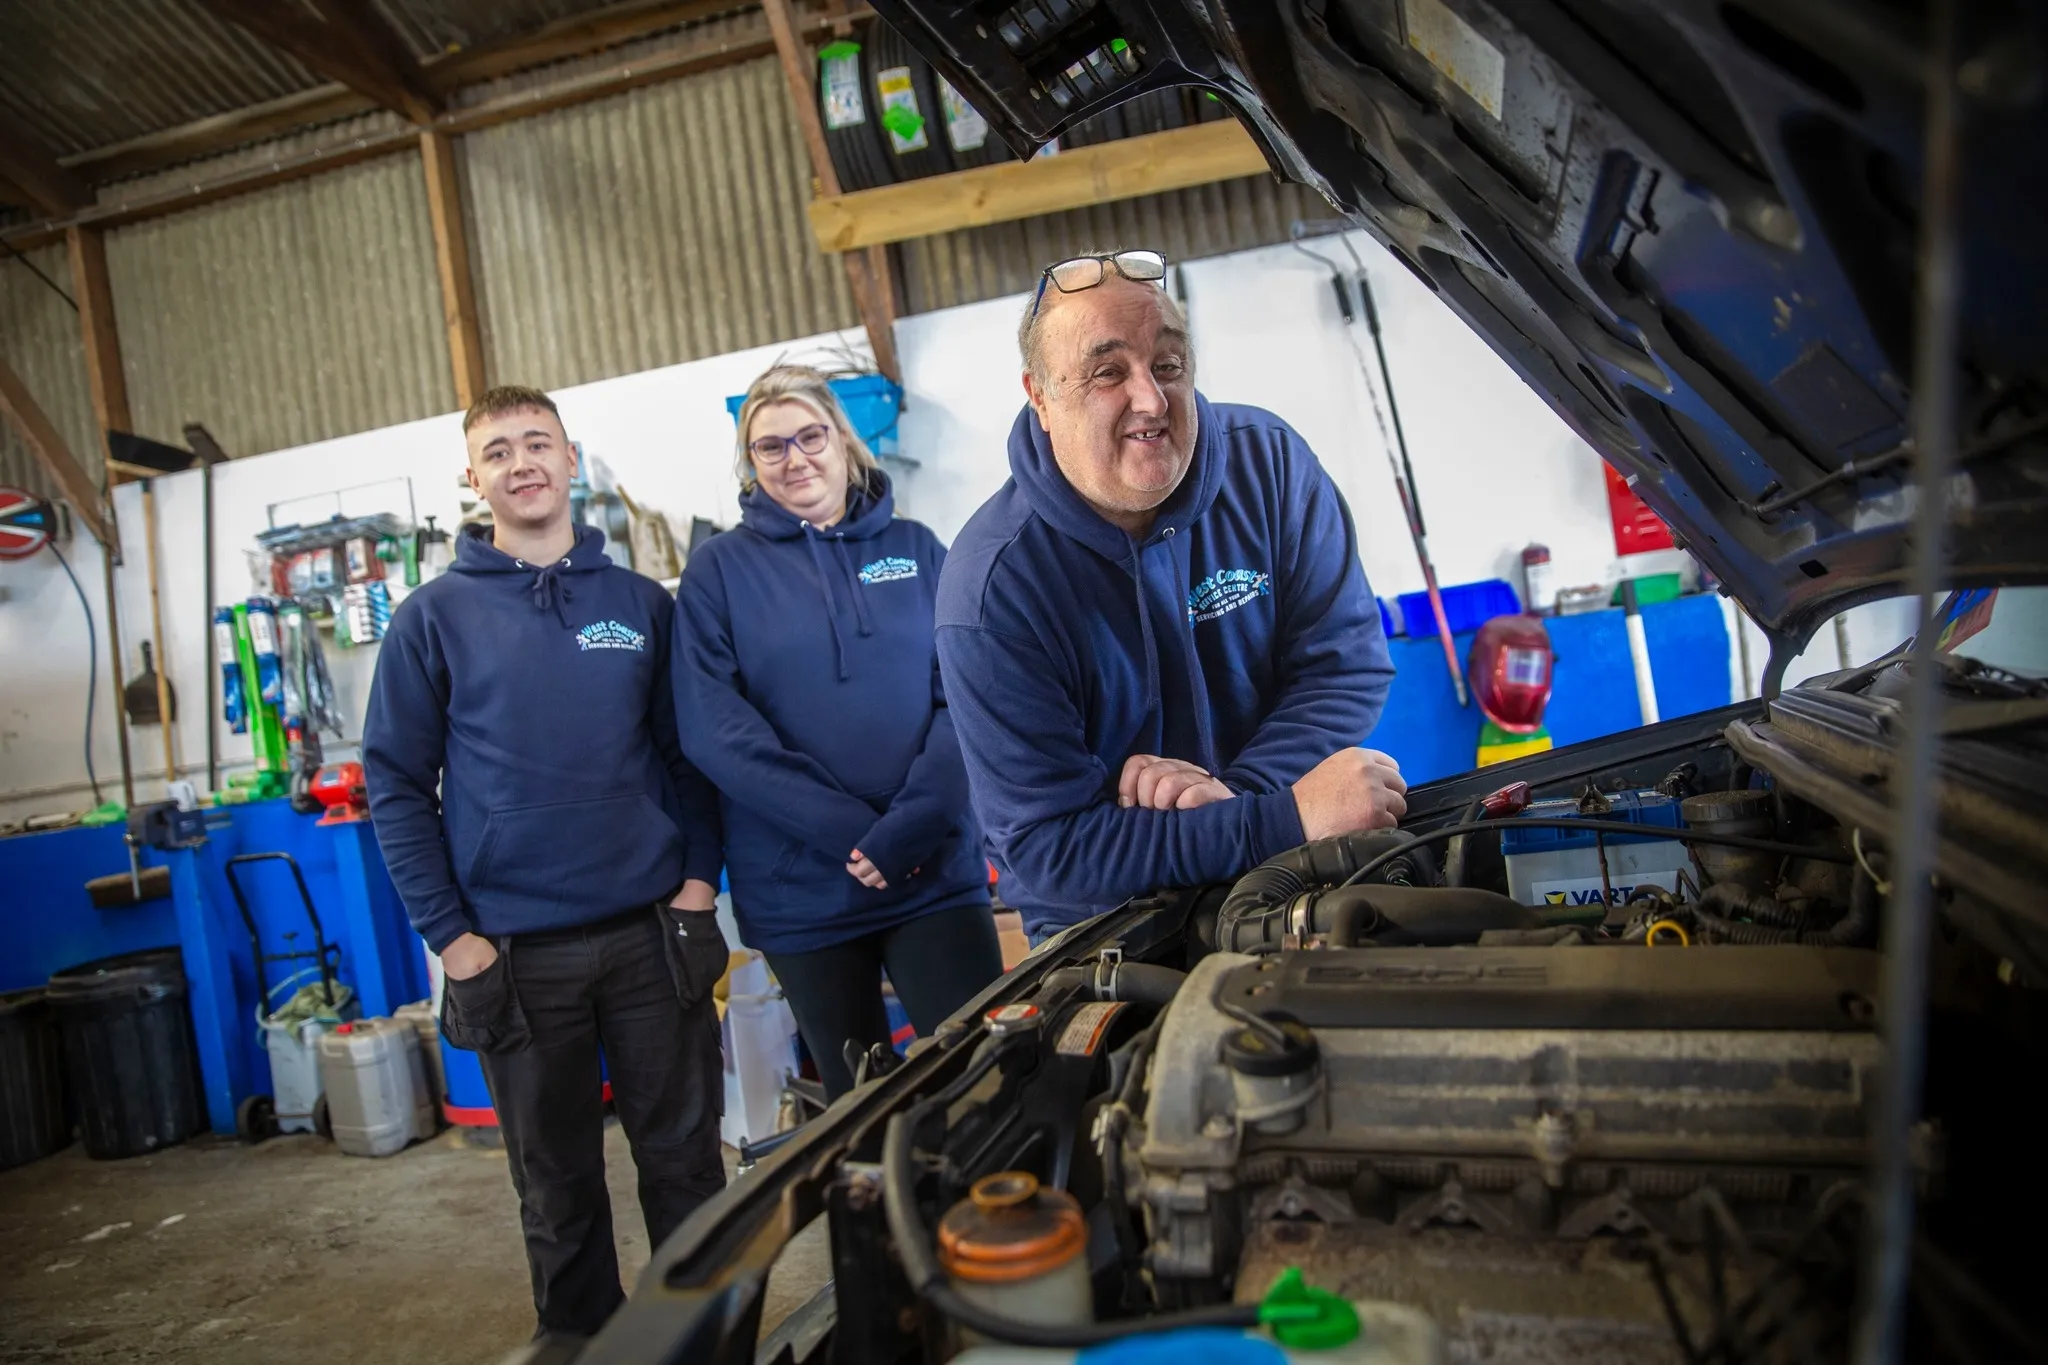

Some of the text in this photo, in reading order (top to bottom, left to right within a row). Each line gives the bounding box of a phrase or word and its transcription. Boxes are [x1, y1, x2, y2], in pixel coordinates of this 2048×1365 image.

[1216, 569, 1258, 584] Coast
[1196, 589, 1259, 622] SERVICING AND REPAIRS
[1199, 583, 1248, 610] SERVICE CENTRE
[581, 620, 607, 638] West
[1571, 886, 1649, 906] VART
